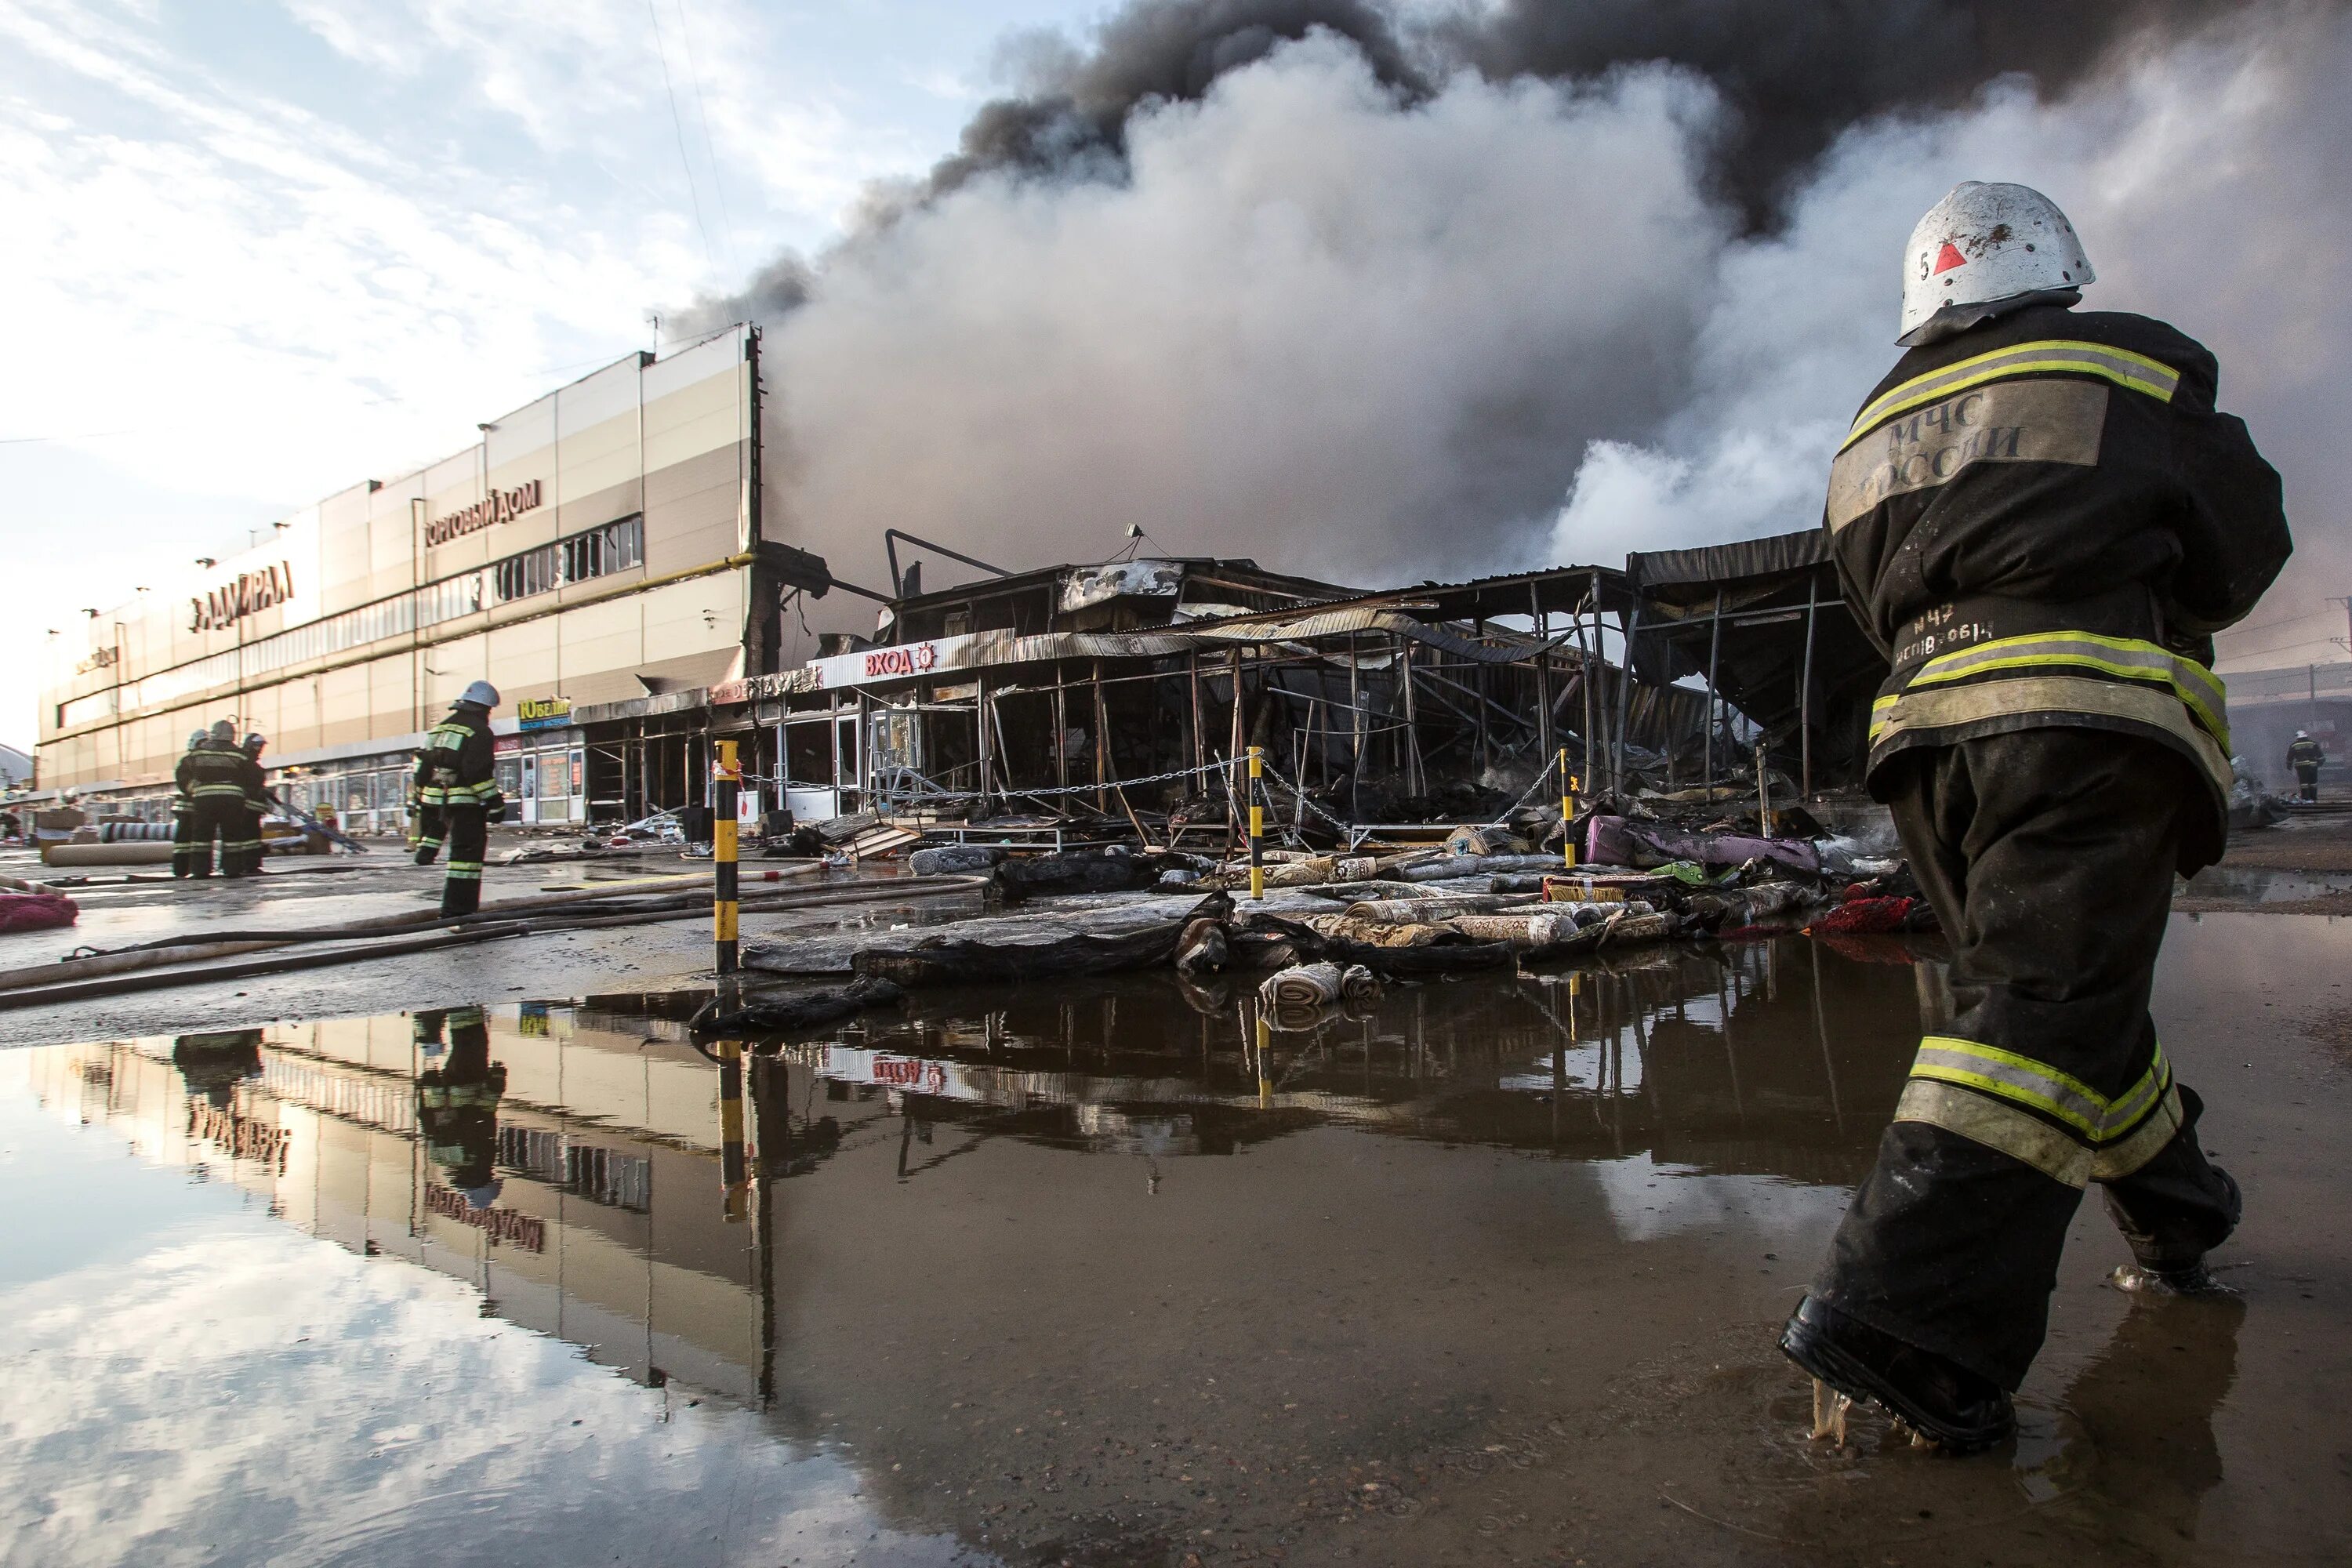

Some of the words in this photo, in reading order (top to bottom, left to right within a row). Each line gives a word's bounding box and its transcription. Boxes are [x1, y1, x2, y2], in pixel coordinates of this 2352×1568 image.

[1921, 252, 1929, 281] 5
[1887, 394, 1984, 452] МЧС
[497, 479, 541, 524] ДОМ
[866, 649, 913, 676] ВХОД
